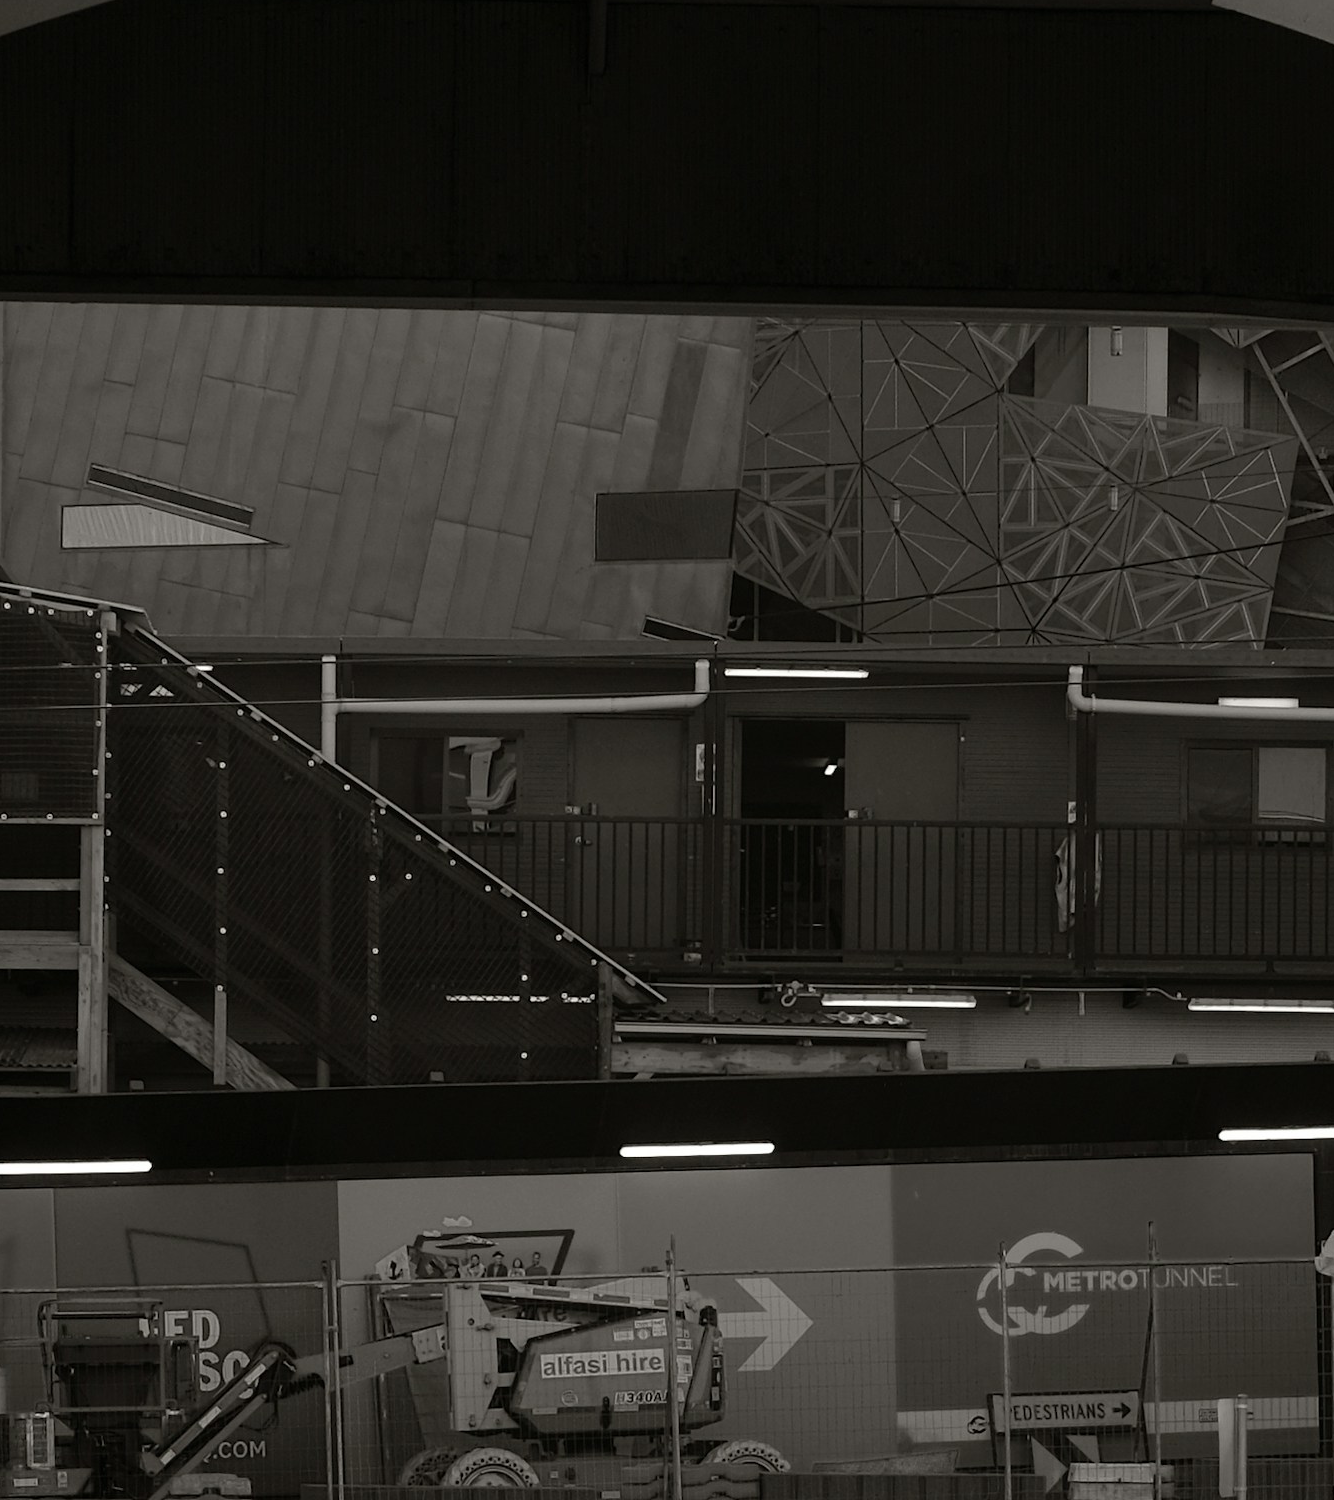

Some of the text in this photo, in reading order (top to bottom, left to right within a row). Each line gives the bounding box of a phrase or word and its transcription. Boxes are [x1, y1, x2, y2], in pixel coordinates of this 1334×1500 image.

[1044, 1267, 1239, 1293] METROTUNNEL
[543, 1353, 662, 1376] alfasi hire
[1010, 1403, 1106, 1421] EDESTRIANS
[203, 1440, 266, 1463] .COM
